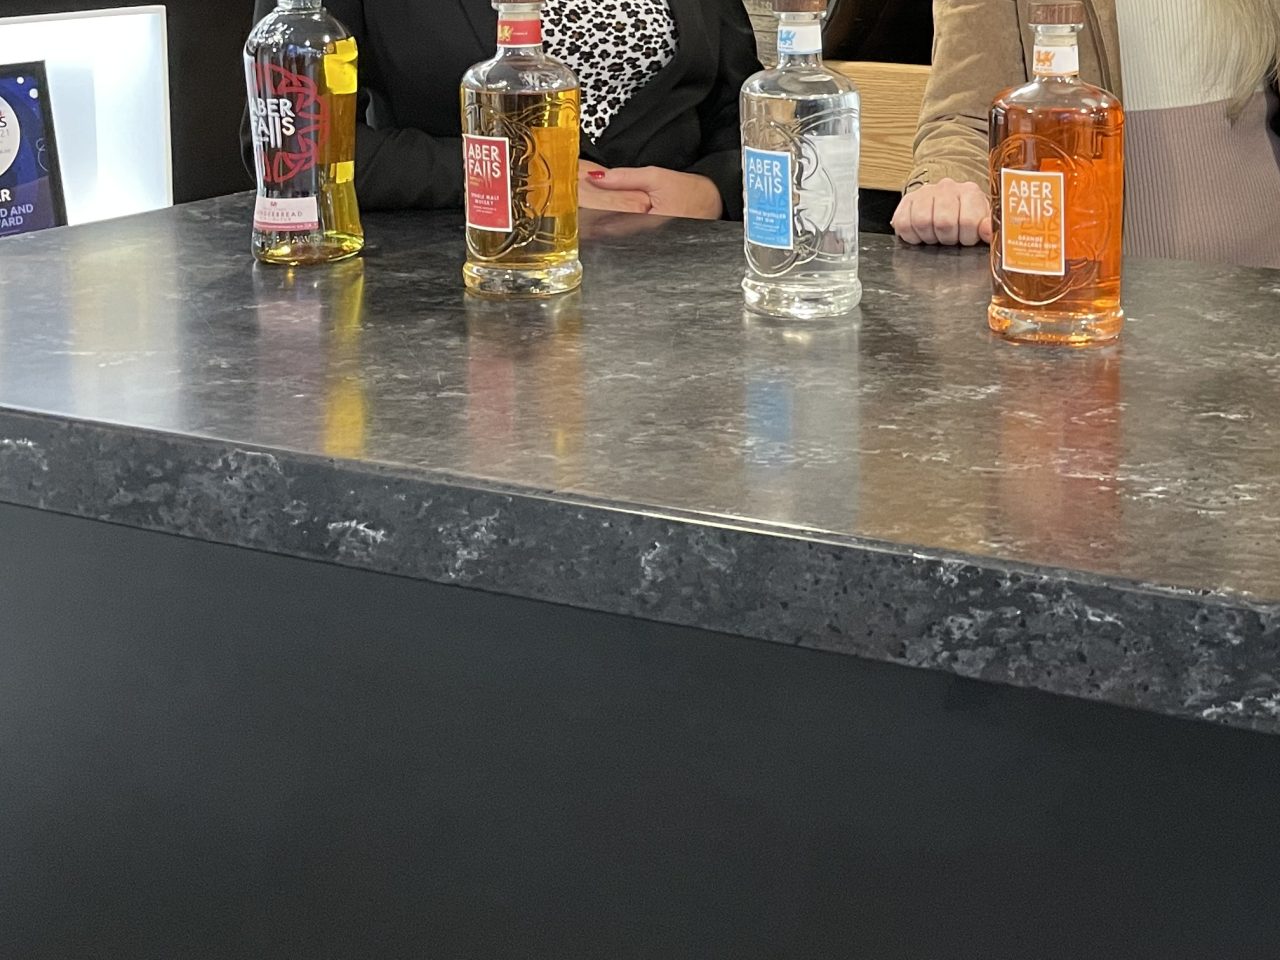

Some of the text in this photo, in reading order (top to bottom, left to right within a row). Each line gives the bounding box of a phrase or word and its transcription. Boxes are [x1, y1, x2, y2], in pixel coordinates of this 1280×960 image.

[468, 143, 502, 163] ABER
[748, 157, 783, 178] ABER
[1008, 179, 1053, 199] ABER
[10, 203, 34, 216] AND
[0, 215, 24, 228] ARD
